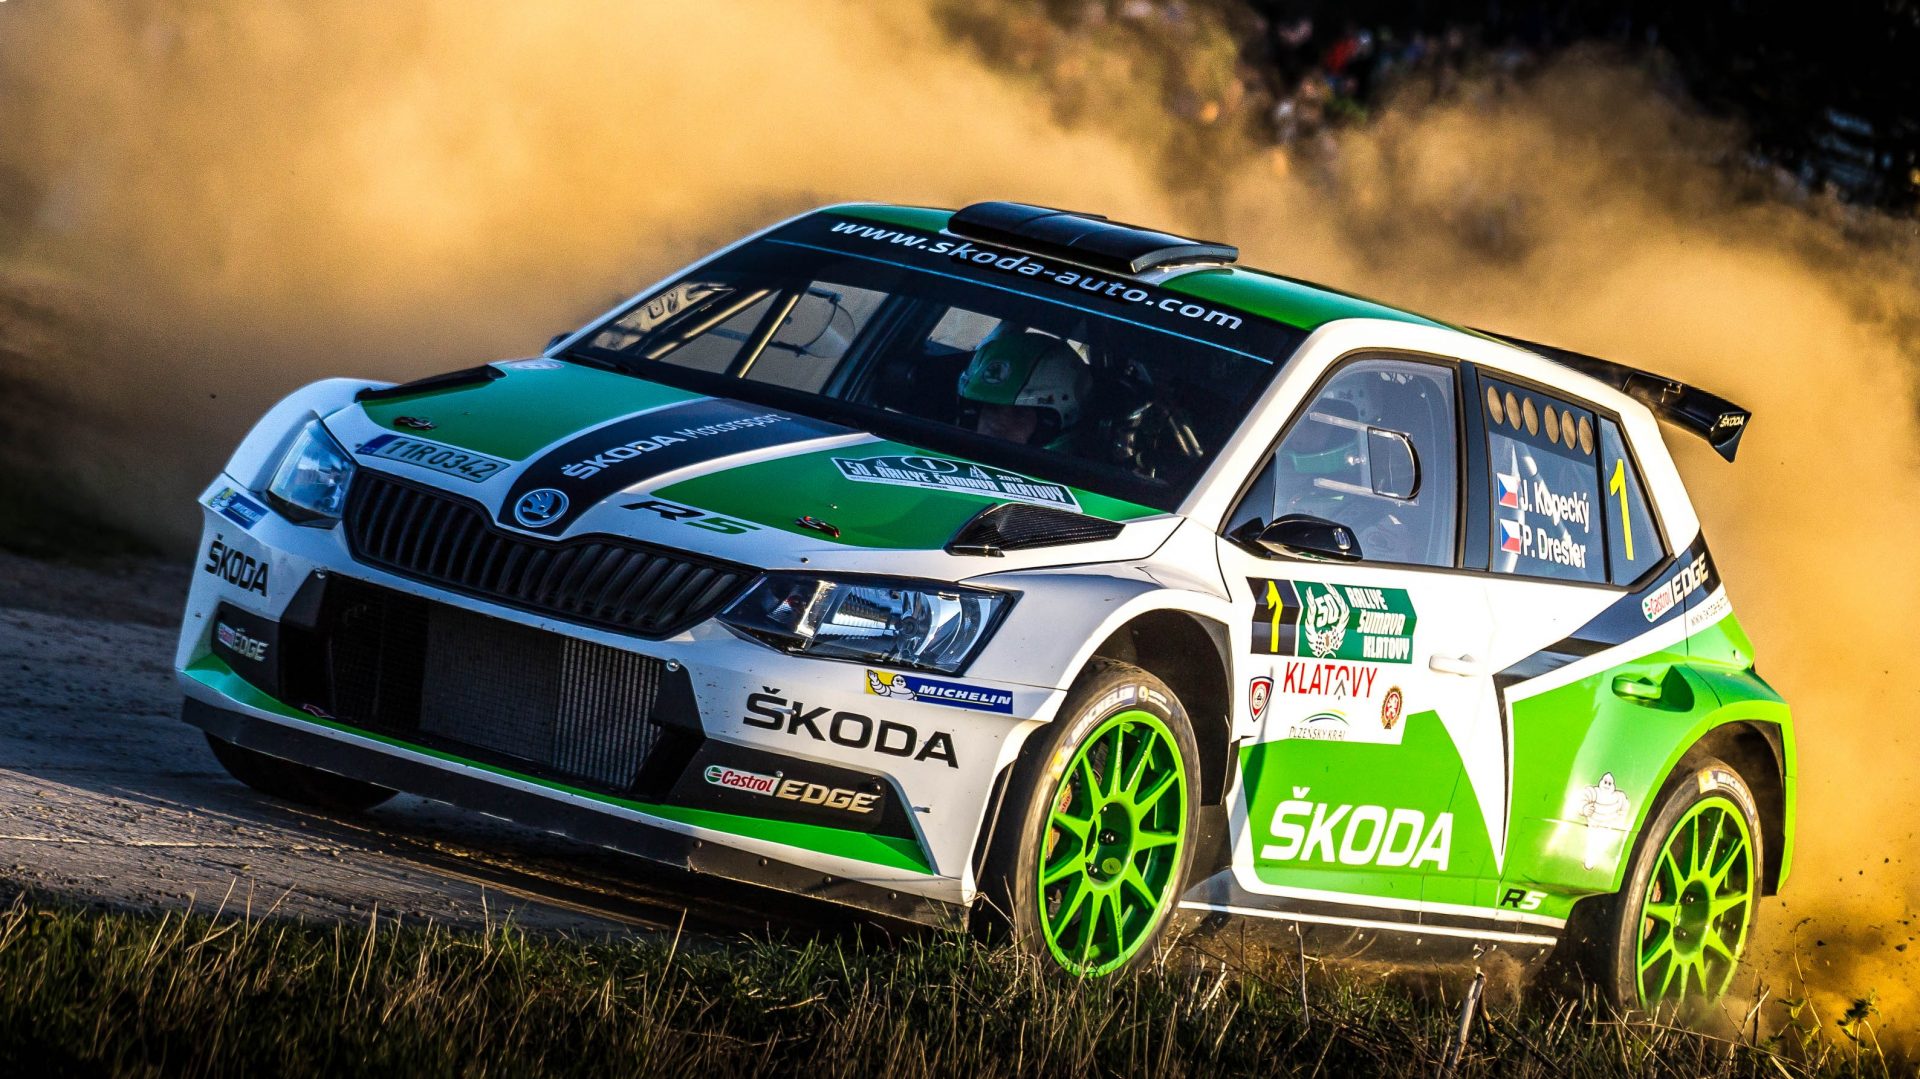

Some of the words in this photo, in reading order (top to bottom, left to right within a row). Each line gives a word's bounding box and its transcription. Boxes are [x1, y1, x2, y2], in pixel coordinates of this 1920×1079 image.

[831, 220, 1243, 331] www.skoda-auto.com
[561, 434, 687, 480] ŠKODA
[674, 413, 792, 440] Motorsport
[874, 466, 932, 483] RALLYE
[1001, 481, 1066, 503] KLATOVY
[1520, 479, 1533, 512] J.
[1534, 481, 1589, 534] Kopecký
[620, 501, 763, 535] R5
[1609, 458, 1634, 561] 1
[1522, 524, 1535, 558] P.
[205, 533, 269, 598] ŠKODA
[1671, 552, 1709, 605] EDGE
[1266, 580, 1284, 653] 1
[1314, 593, 1340, 627] 50
[1345, 587, 1389, 611] RALLYE
[1363, 635, 1410, 660] KLATOVY
[918, 684, 1012, 706] MICHELIN
[1283, 661, 1378, 698] KLATOVY
[743, 685, 959, 769] ŠKODA
[721, 769, 775, 793] Castrol
[776, 780, 882, 814] EDGE
[1260, 786, 1454, 872] ŠKODA
[1500, 888, 1549, 911] R5
